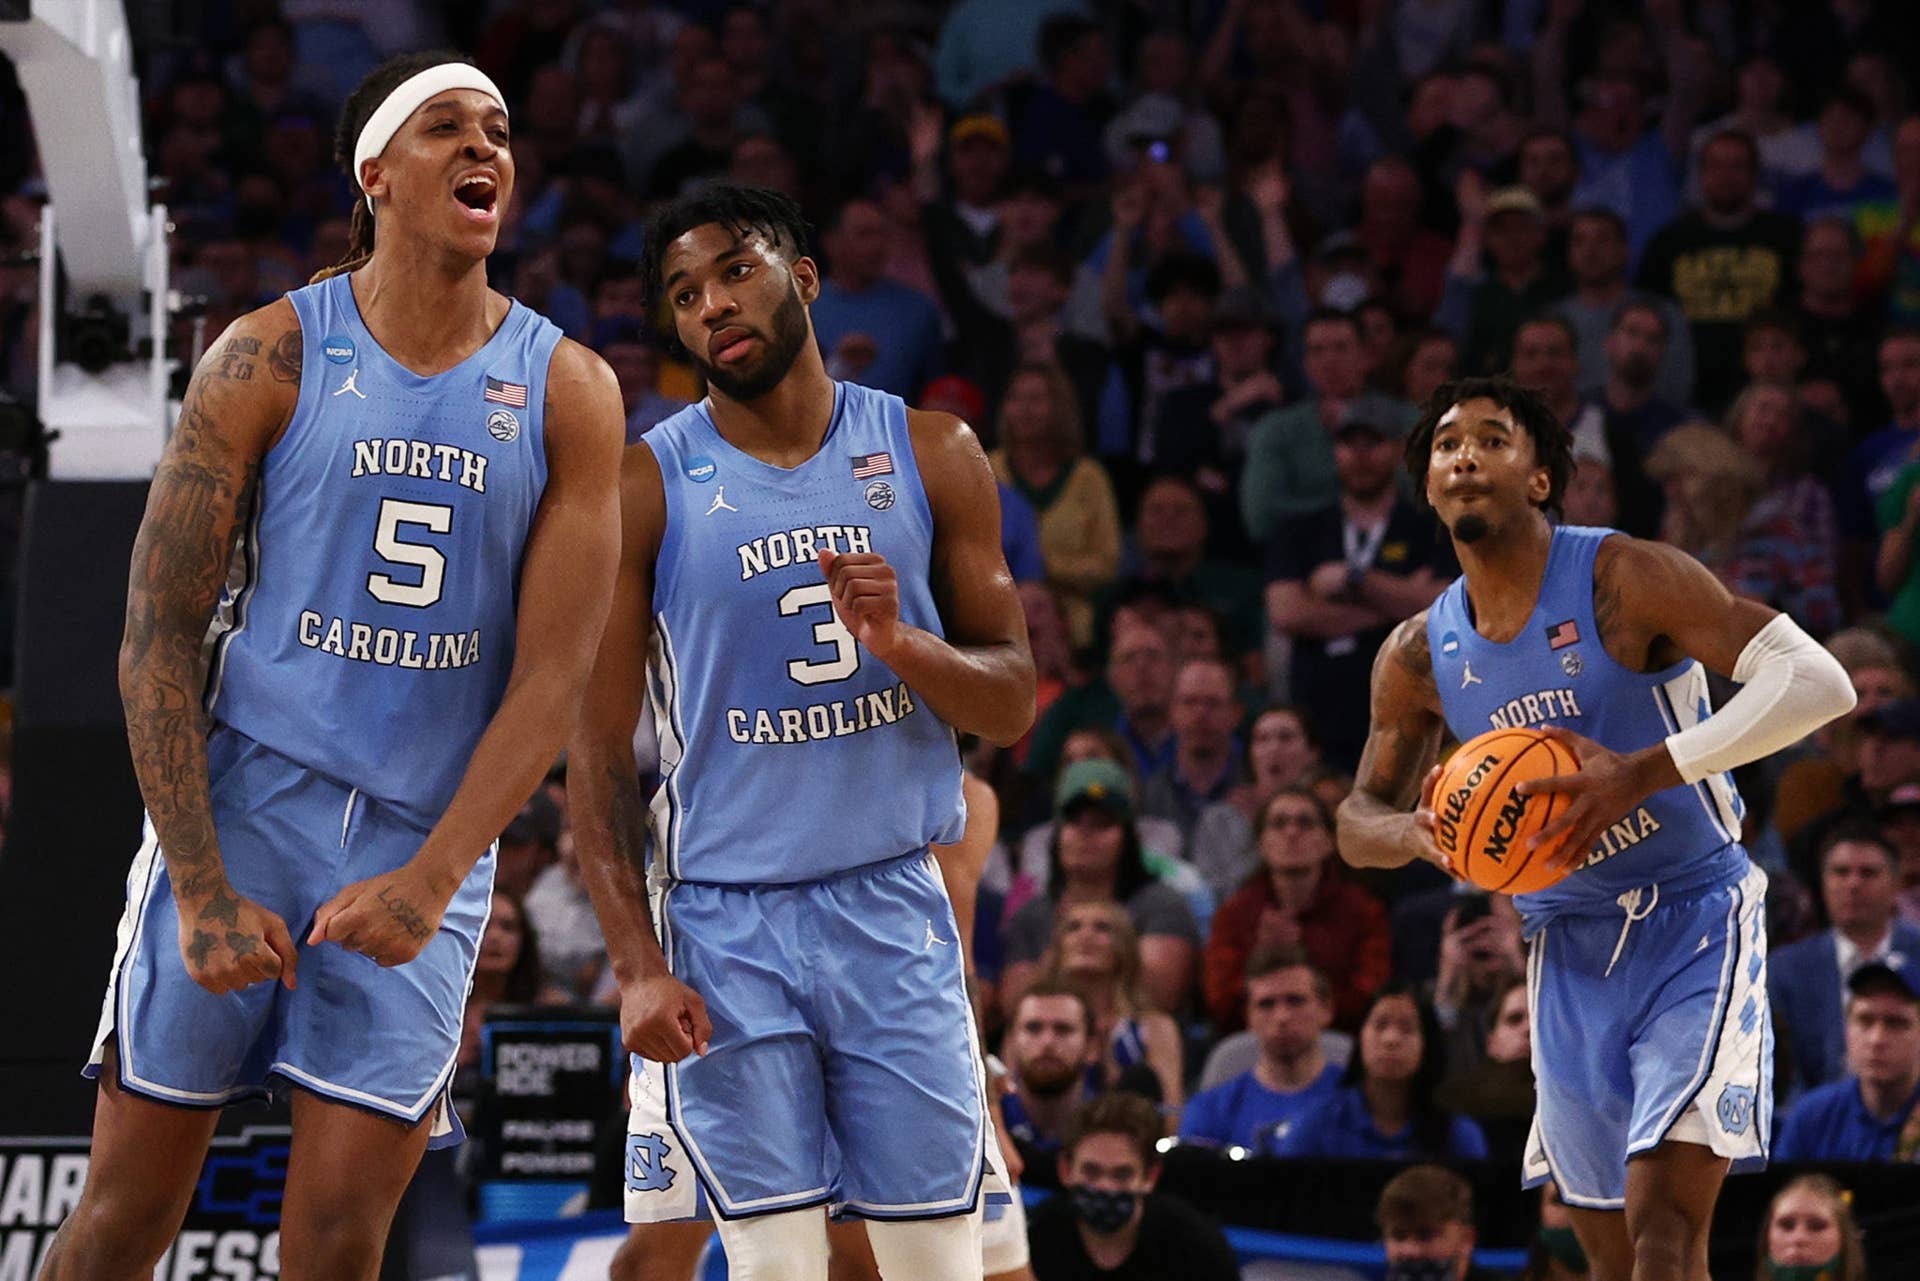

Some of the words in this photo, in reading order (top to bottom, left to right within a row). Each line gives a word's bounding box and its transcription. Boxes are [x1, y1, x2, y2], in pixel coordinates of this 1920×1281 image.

[351, 438, 489, 494] NORTH
[366, 496, 453, 609] 5
[736, 525, 874, 581] NORTH
[298, 609, 481, 670] CAROLINA
[778, 582, 861, 686] 3
[726, 682, 915, 744] CAROLINA
[1489, 687, 1583, 731] NORTH
[1441, 754, 1500, 852] Wilson
[1483, 787, 1533, 864] NCAA
